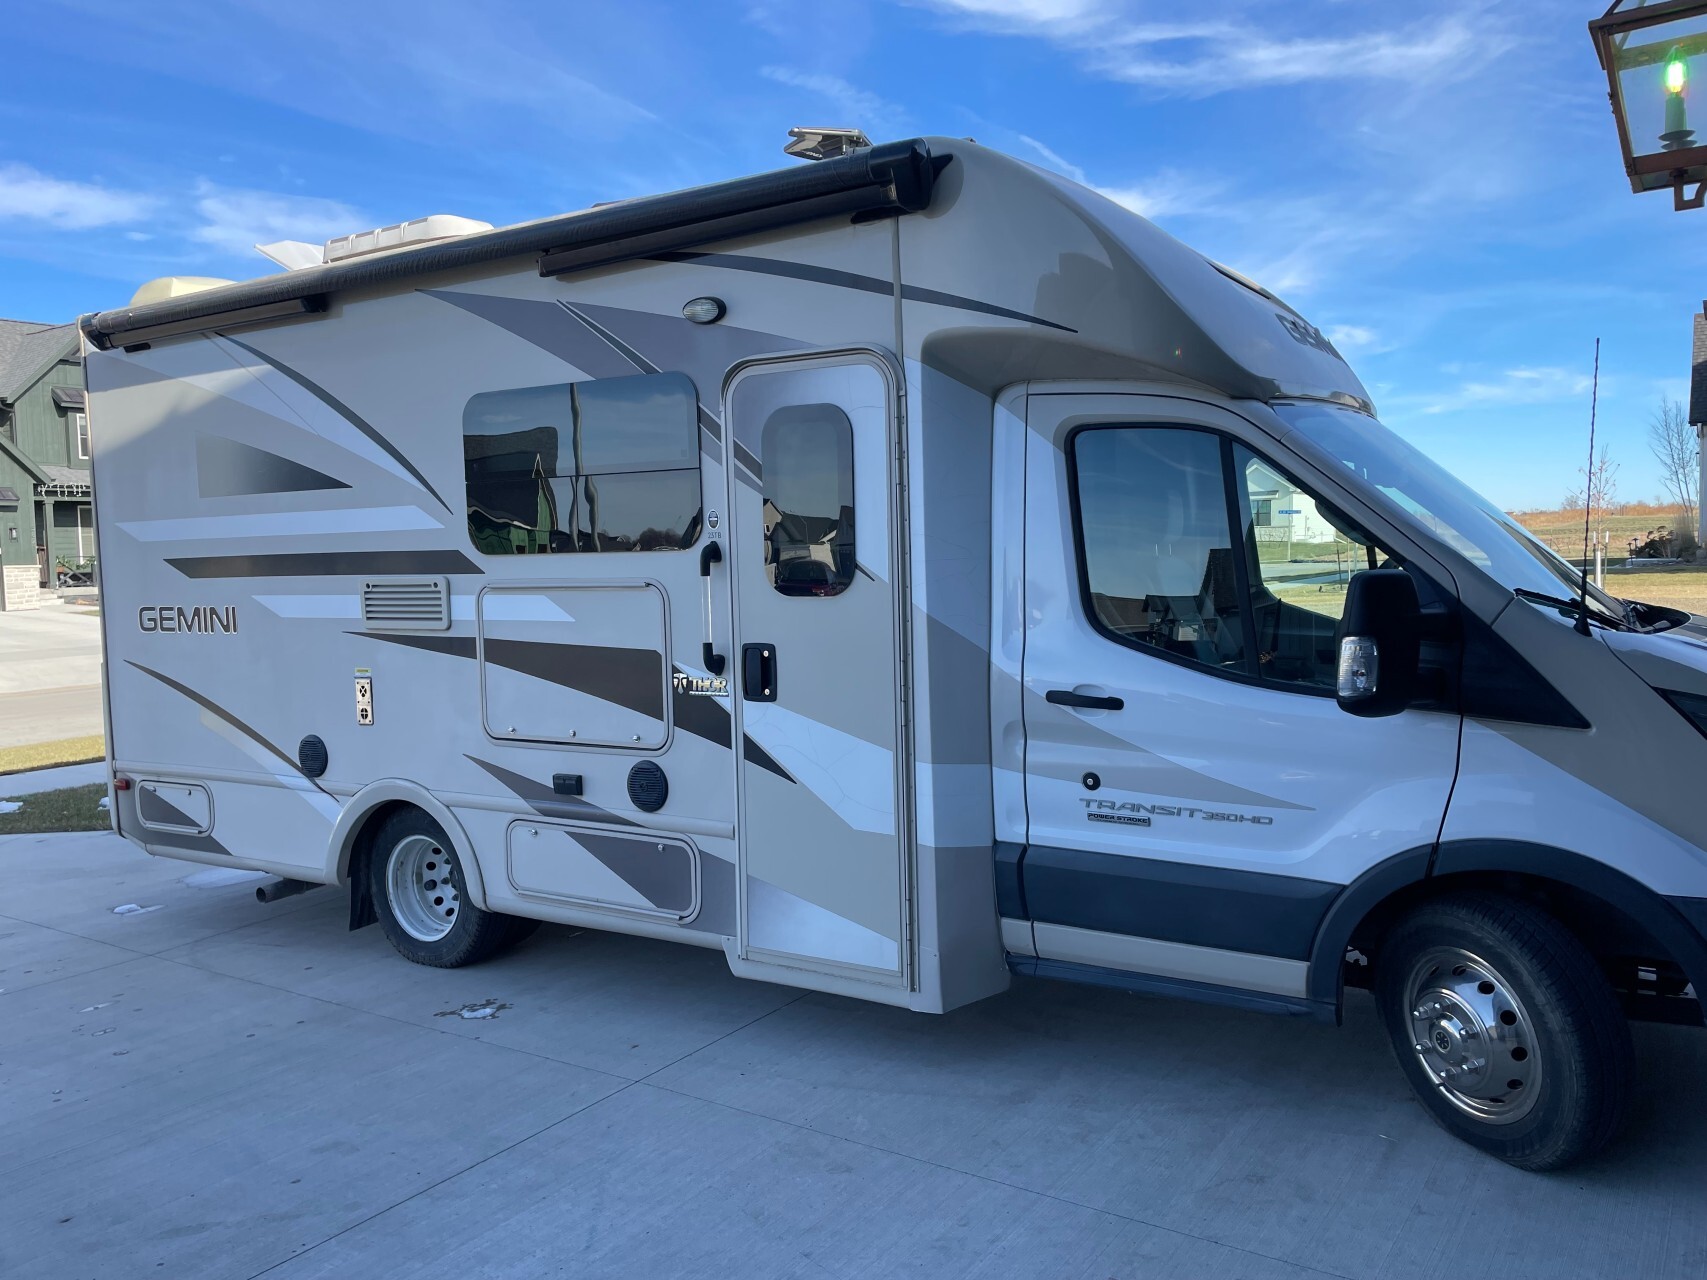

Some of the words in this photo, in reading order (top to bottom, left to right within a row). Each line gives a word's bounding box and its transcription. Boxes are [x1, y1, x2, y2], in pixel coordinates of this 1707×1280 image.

[138, 605, 238, 635] GEMINI
[689, 676, 729, 692] THOR
[1088, 812, 1115, 820] POWER
[1116, 815, 1148, 824] STROKE
